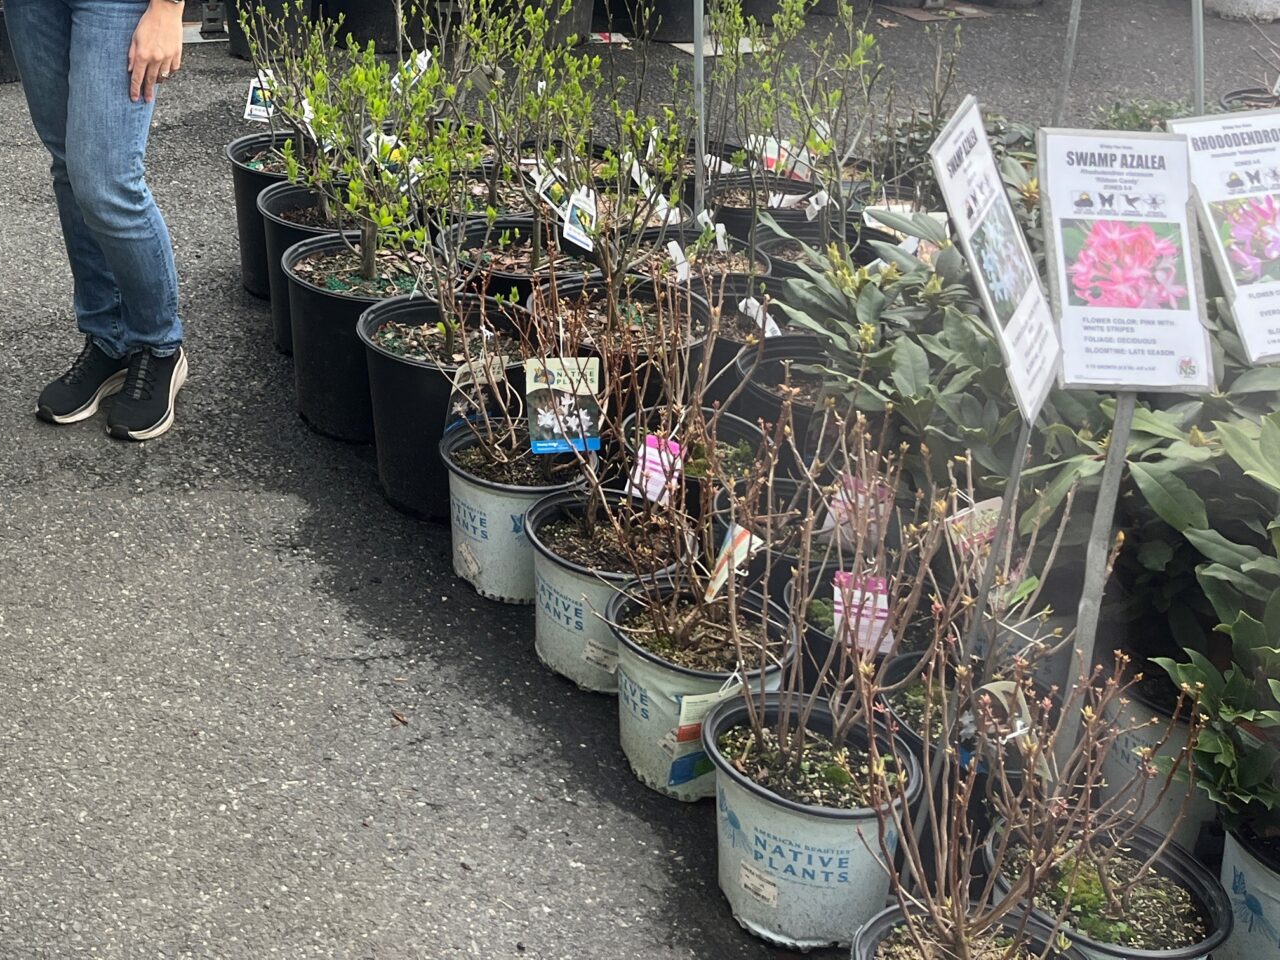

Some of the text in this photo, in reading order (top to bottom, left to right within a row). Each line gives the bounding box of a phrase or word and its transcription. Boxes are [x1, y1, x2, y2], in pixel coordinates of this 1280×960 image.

[1190, 128, 1280, 152] RHODODENDRO
[947, 149, 964, 179] SWAMP
[1066, 151, 1166, 170] SWAMP AZALEA
[1082, 317, 1111, 325] FLOWER
[557, 377, 594, 385] PLNS
[539, 595, 584, 631] LANTS
[754, 826, 801, 848] AMERICAN
[754, 834, 849, 869] NATIVE
[753, 849, 849, 883] PLANTS
